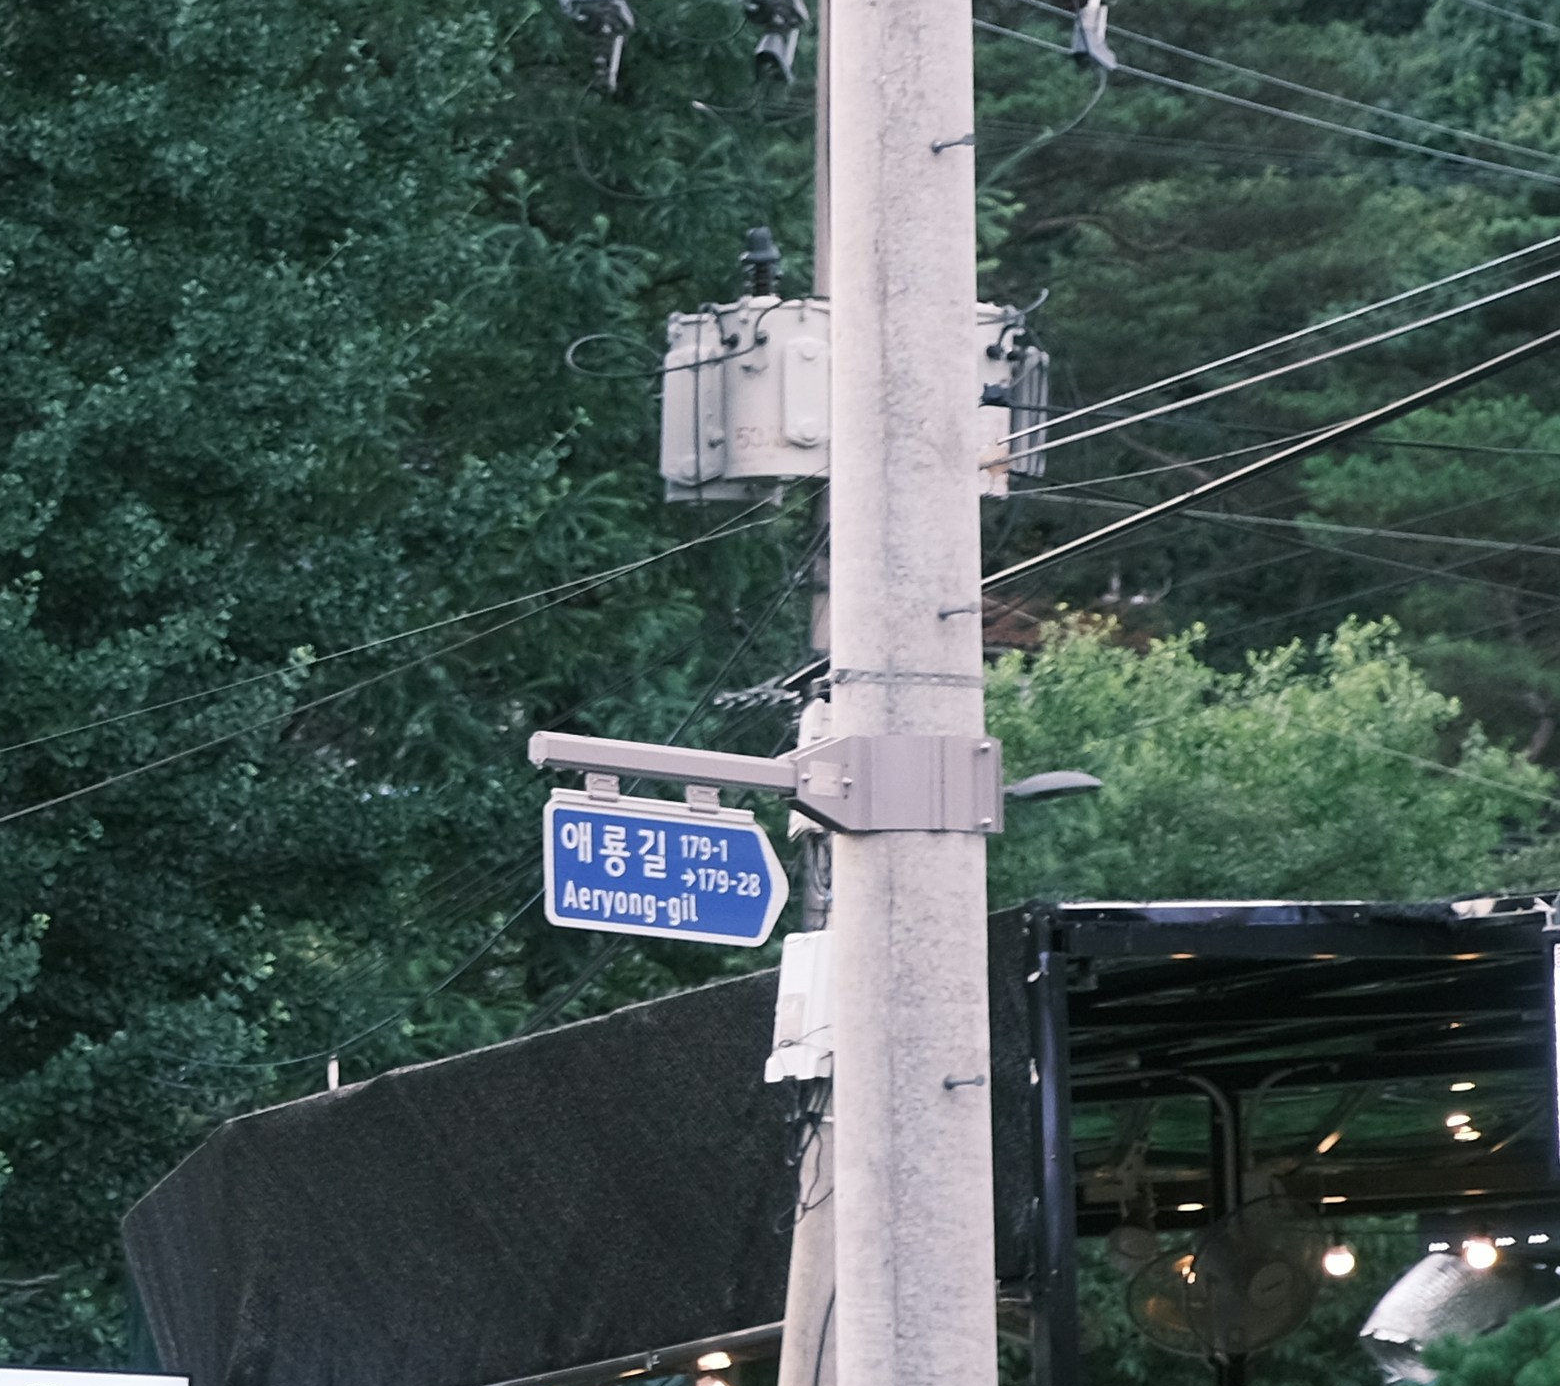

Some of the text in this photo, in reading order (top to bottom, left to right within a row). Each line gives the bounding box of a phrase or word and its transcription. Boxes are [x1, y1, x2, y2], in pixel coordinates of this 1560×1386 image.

[560, 821, 729, 880] 애룡길 179-1
[562, 879, 699, 927] Aeryong-gil
[696, 867, 762, 898] 179-28
